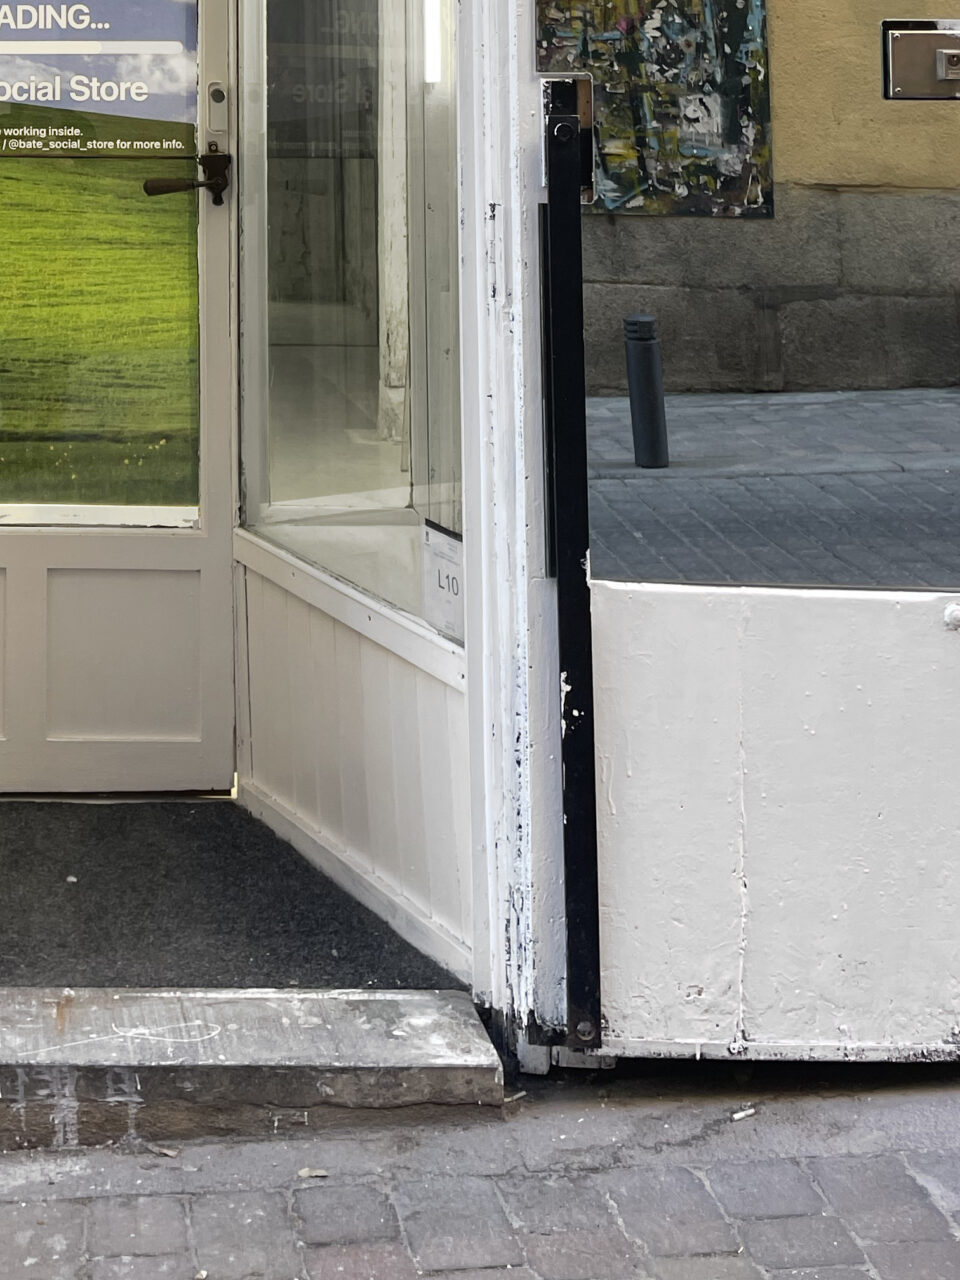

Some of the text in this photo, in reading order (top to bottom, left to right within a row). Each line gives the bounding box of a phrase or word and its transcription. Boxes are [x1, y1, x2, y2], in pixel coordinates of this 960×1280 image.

[69, 74, 149, 101] Store
[3, 126, 47, 138] working
[48, 126, 83, 136] inside.
[8, 138, 114, 151] @bate_social_store
[116, 139, 131, 149] for
[133, 140, 160, 149] more
[162, 138, 185, 149] info.
[437, 568, 459, 596] L10
